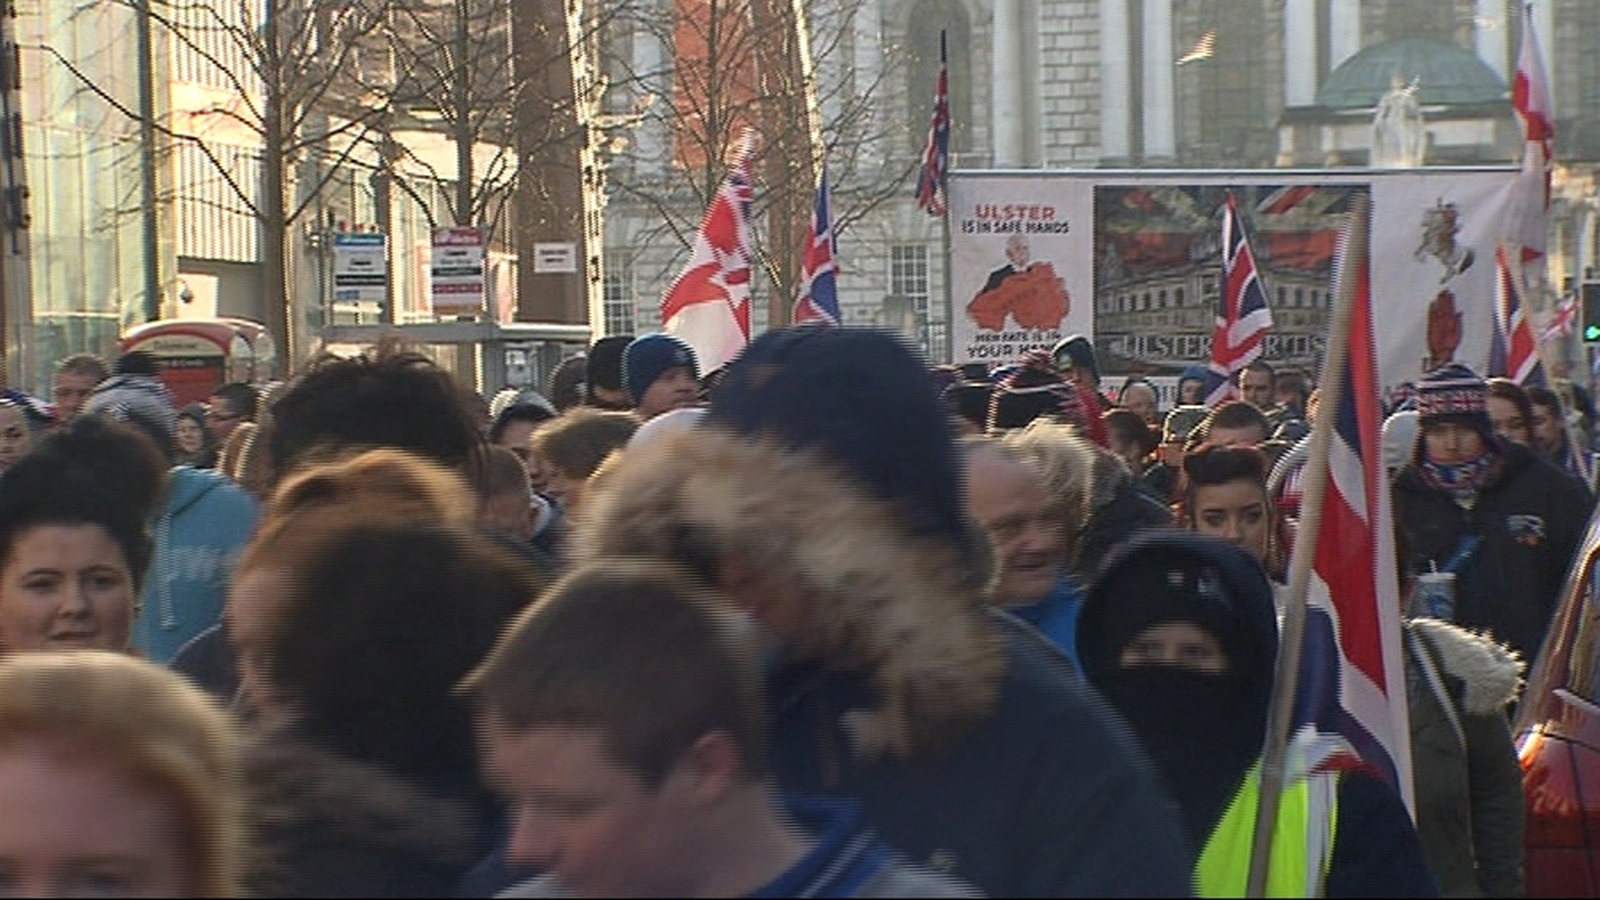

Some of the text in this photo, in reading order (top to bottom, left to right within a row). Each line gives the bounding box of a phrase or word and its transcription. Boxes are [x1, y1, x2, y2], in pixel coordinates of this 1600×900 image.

[975, 203, 1056, 220] ULSTER
[962, 219, 1070, 234] IS IN SAFE HANDS
[967, 343, 1013, 358] YOUR
[1122, 335, 1213, 358] ULSTER
